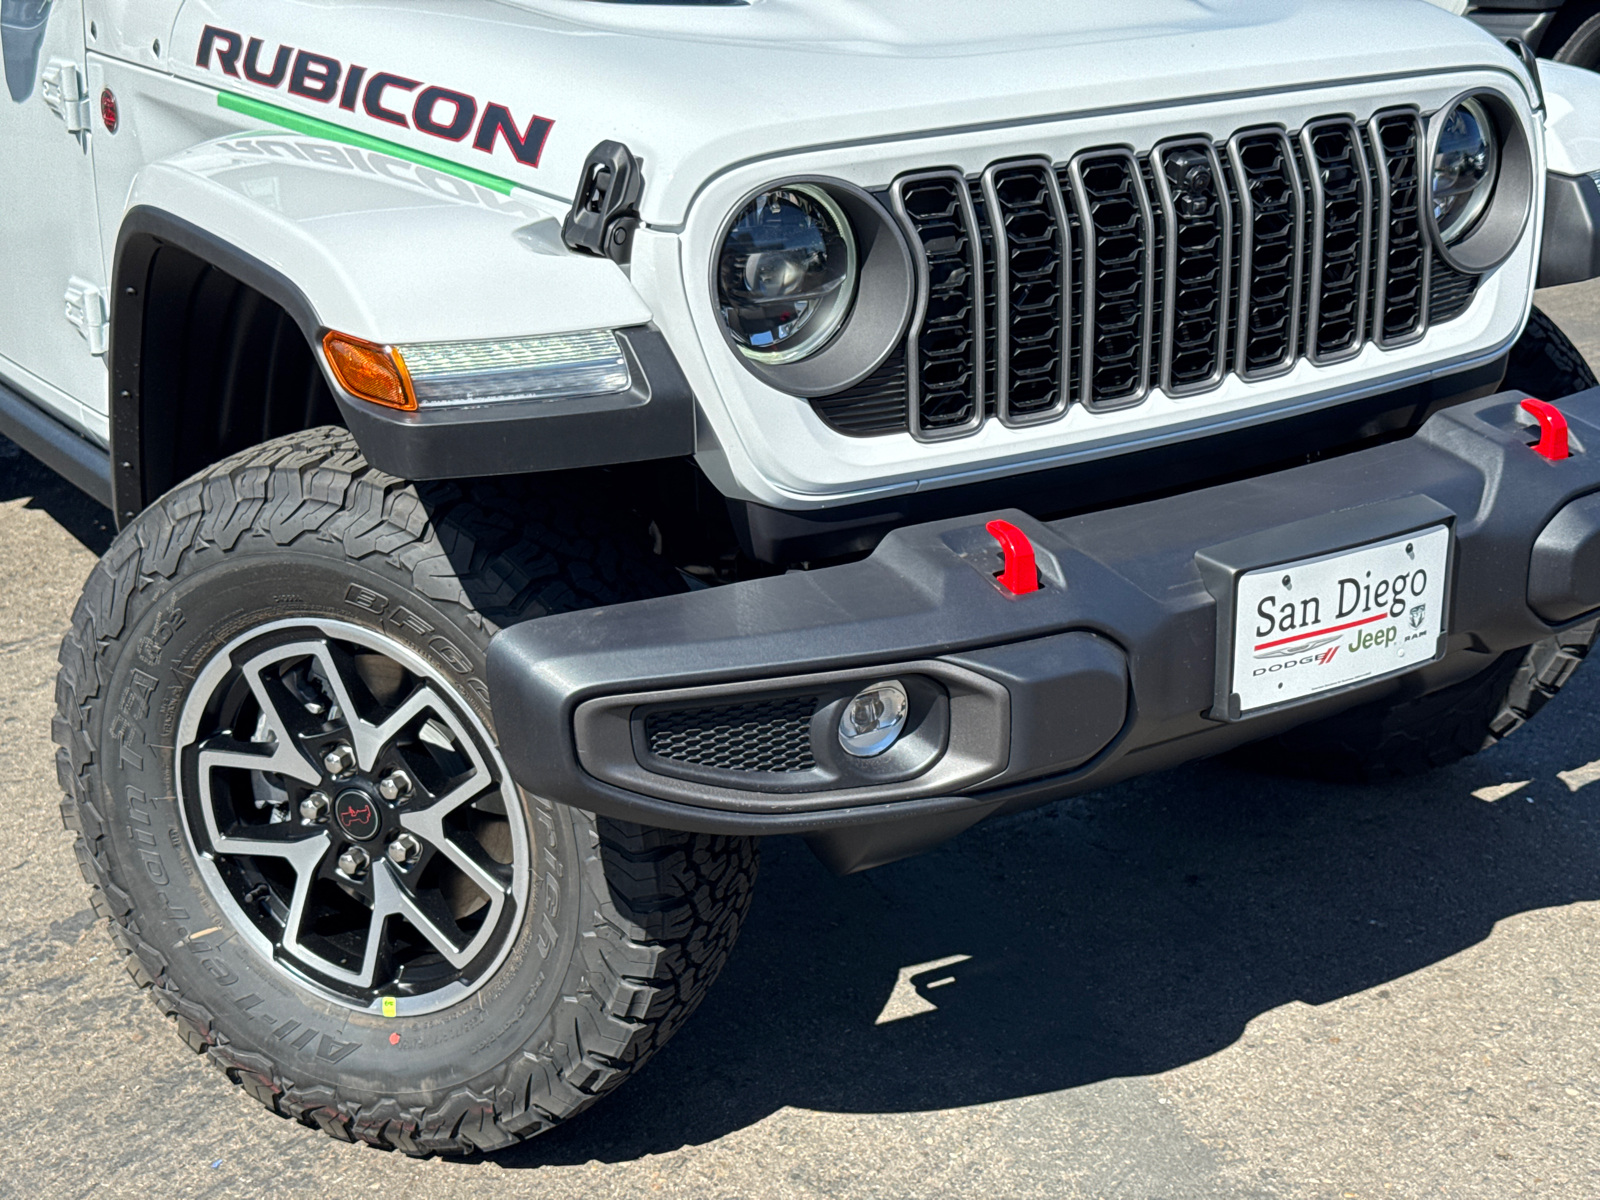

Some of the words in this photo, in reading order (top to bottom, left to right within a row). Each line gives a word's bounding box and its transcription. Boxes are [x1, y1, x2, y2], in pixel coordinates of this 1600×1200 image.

[195, 24, 556, 169] RUBICON
[1256, 595, 1321, 638] San
[1335, 568, 1427, 618] Diego
[1348, 625, 1397, 653] Jeep
[1404, 630, 1427, 642] RAM
[1253, 653, 1327, 677] DODGE
